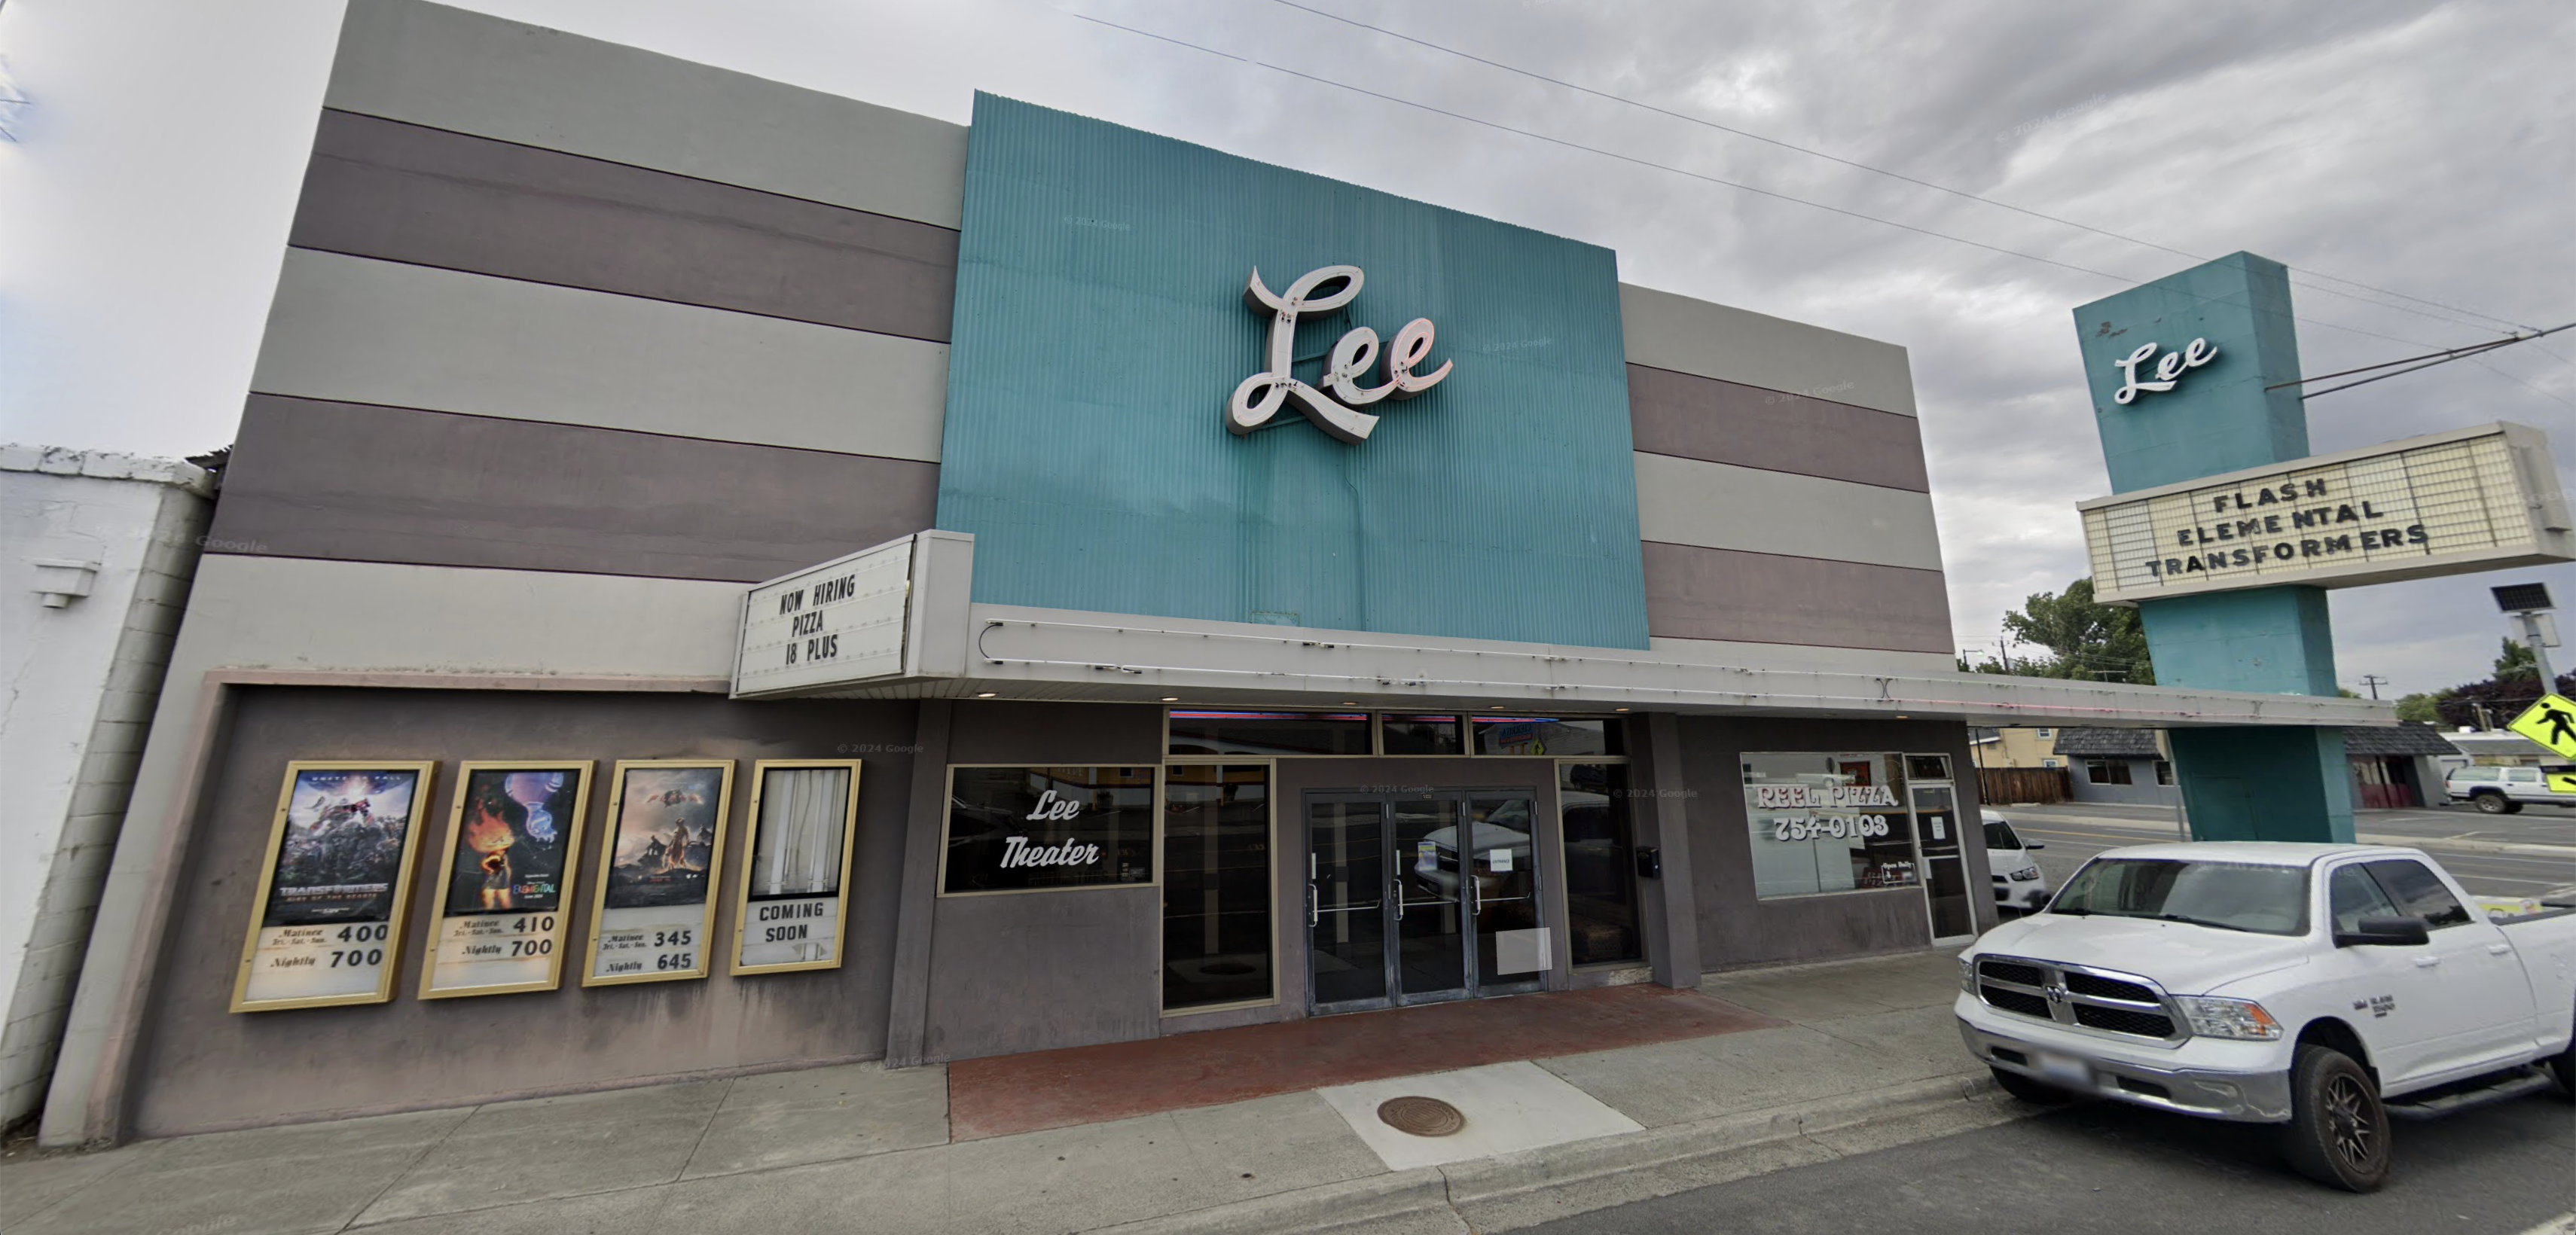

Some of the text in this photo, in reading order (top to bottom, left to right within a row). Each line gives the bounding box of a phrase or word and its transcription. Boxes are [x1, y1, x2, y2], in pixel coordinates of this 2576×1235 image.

[1225, 264, 1454, 446] Lee
[2114, 337, 2218, 405] Lee
[2213, 477, 2327, 514] FLASH
[2177, 500, 2384, 547] ELEMENTAL
[2145, 524, 2429, 578] TRANSFORMERS
[780, 574, 855, 615] NOW HIRING
[792, 609, 823, 638] PIZZA
[786, 634, 838, 666] 18 PLUS
[1026, 789, 1080, 821] Lee
[1757, 785, 1899, 809] REEL PIZZA
[1773, 814, 1889, 841] 754-0103
[1000, 836, 1100, 868] Theater
[459, 916, 554, 933] Matinee 410
[759, 902, 824, 922] COMING
[279, 924, 389, 942] Matinee 400
[608, 930, 691, 947] Matinee 345
[765, 924, 807, 943] SOON
[270, 949, 383, 968] Nightly 700
[462, 939, 552, 956] Nightly 700
[606, 953, 691, 972] Nightly 645
